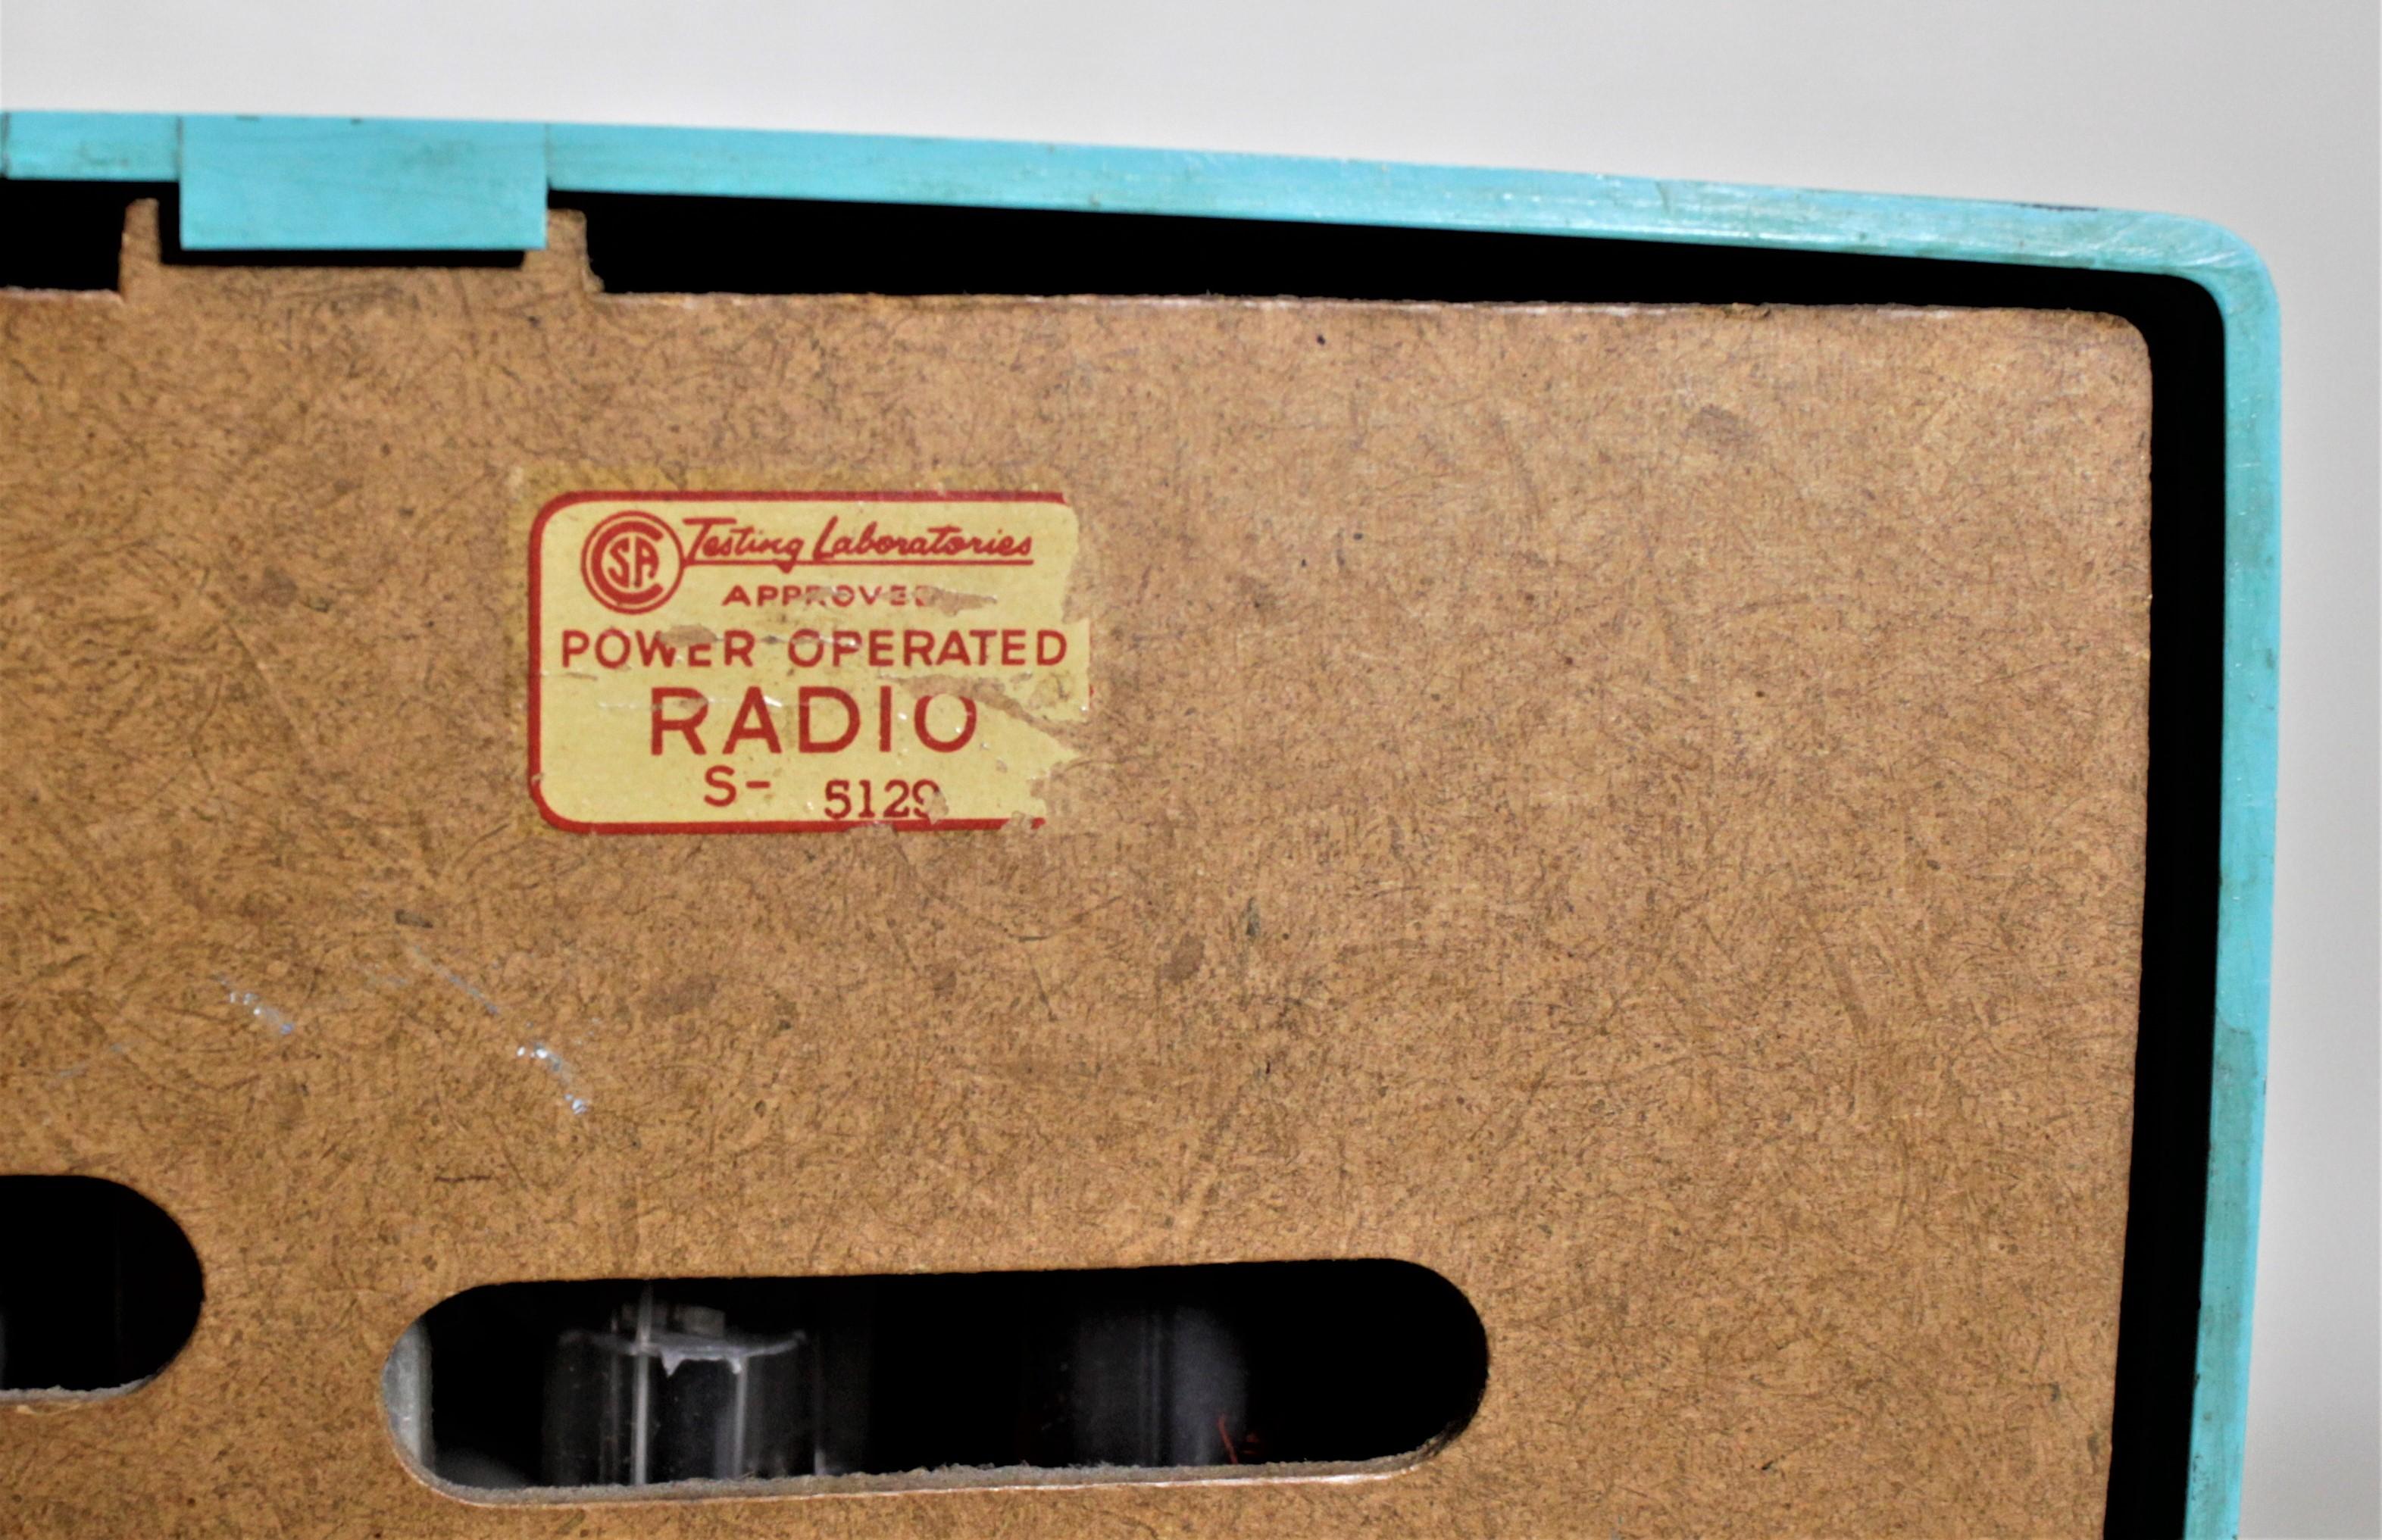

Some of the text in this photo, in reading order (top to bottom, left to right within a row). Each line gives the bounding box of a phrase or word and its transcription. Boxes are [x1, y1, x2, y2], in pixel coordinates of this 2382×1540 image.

[683, 517, 805, 573] Testing
[812, 515, 1033, 563] Laboratories
[561, 628, 1068, 670] POWER OPERATED
[650, 685, 978, 756] RADIO
